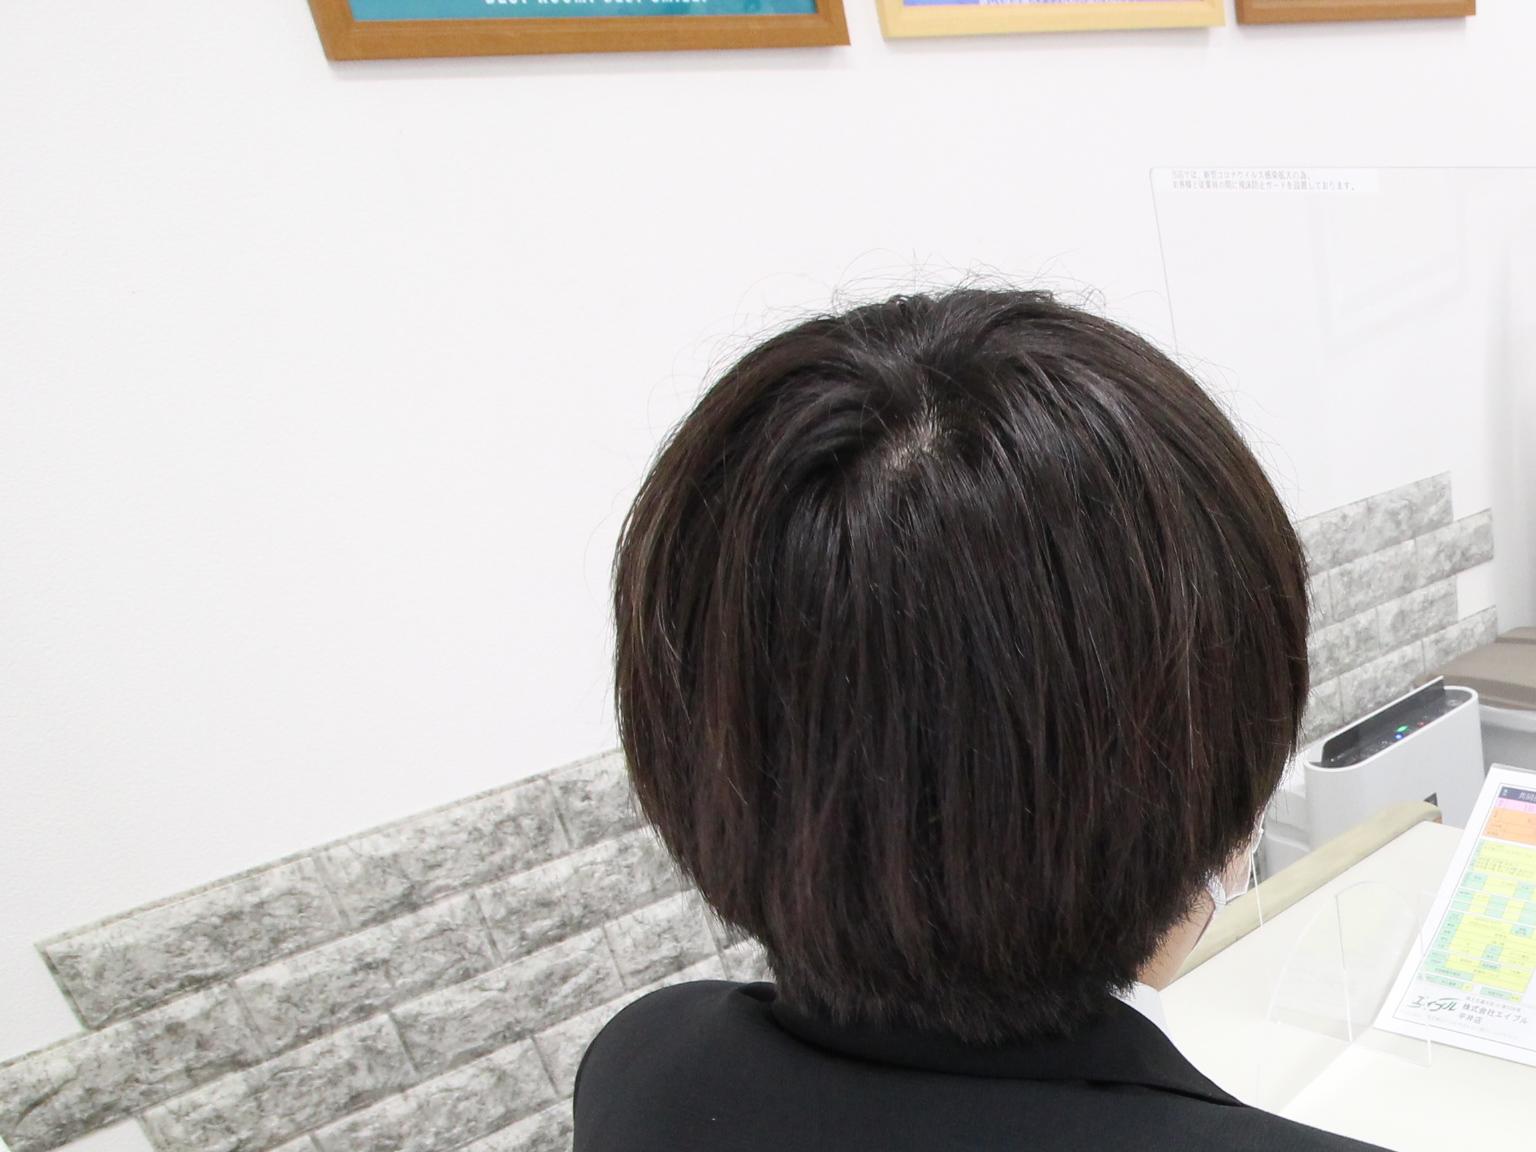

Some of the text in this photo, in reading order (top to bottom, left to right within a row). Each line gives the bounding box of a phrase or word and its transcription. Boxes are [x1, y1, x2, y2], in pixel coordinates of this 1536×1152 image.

[1461, 1002, 1529, 1026] 株式会社エイブル
